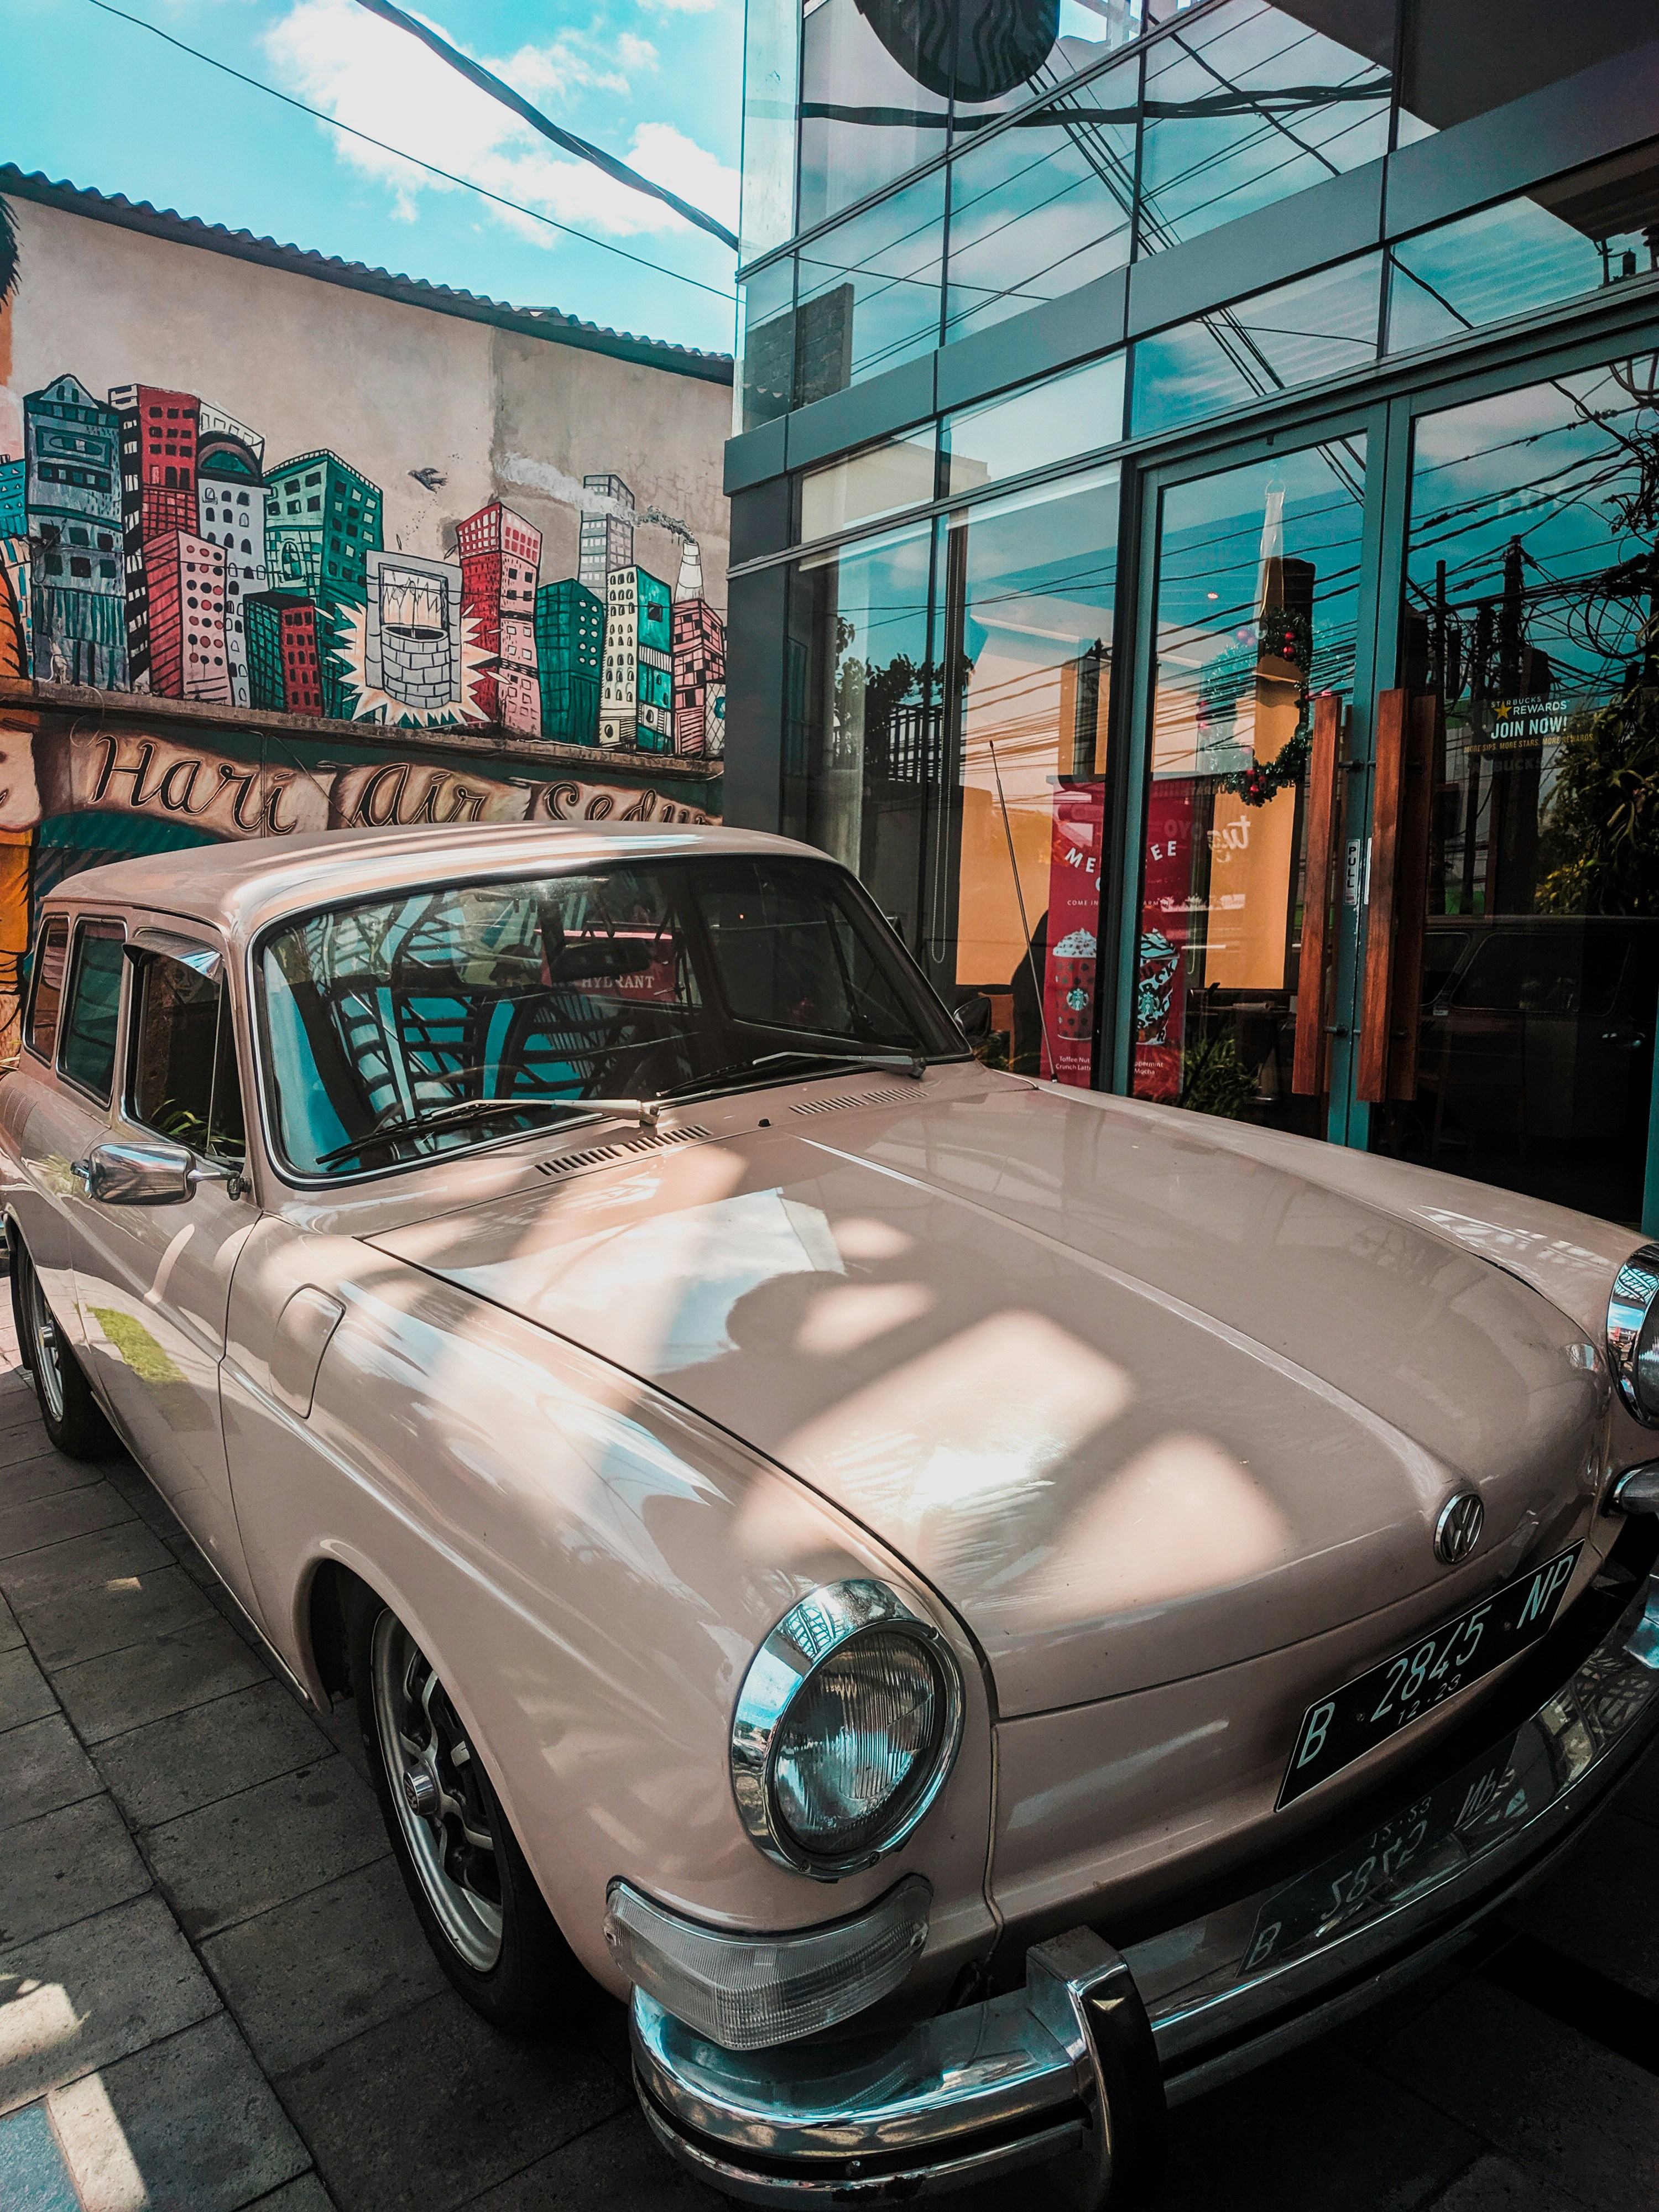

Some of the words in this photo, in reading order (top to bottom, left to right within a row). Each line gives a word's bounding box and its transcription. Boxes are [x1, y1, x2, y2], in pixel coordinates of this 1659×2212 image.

[1491, 696, 1541, 708] STARBUCKS
[1490, 720, 1525, 739] JOIN
[1529, 716, 1567, 735] NOW!
[1464, 744, 1481, 753] MORE
[1499, 741, 1517, 750] MORE
[1542, 737, 1561, 745] MORE
[88, 735, 298, 834] Hari
[1347, 847, 1356, 888] PULL
[582, 974, 655, 989] HYDRANT
[1297, 1702, 1335, 1769] B
[1370, 1604, 1492, 1722] 2845
[1516, 1554, 1574, 1629] NP
